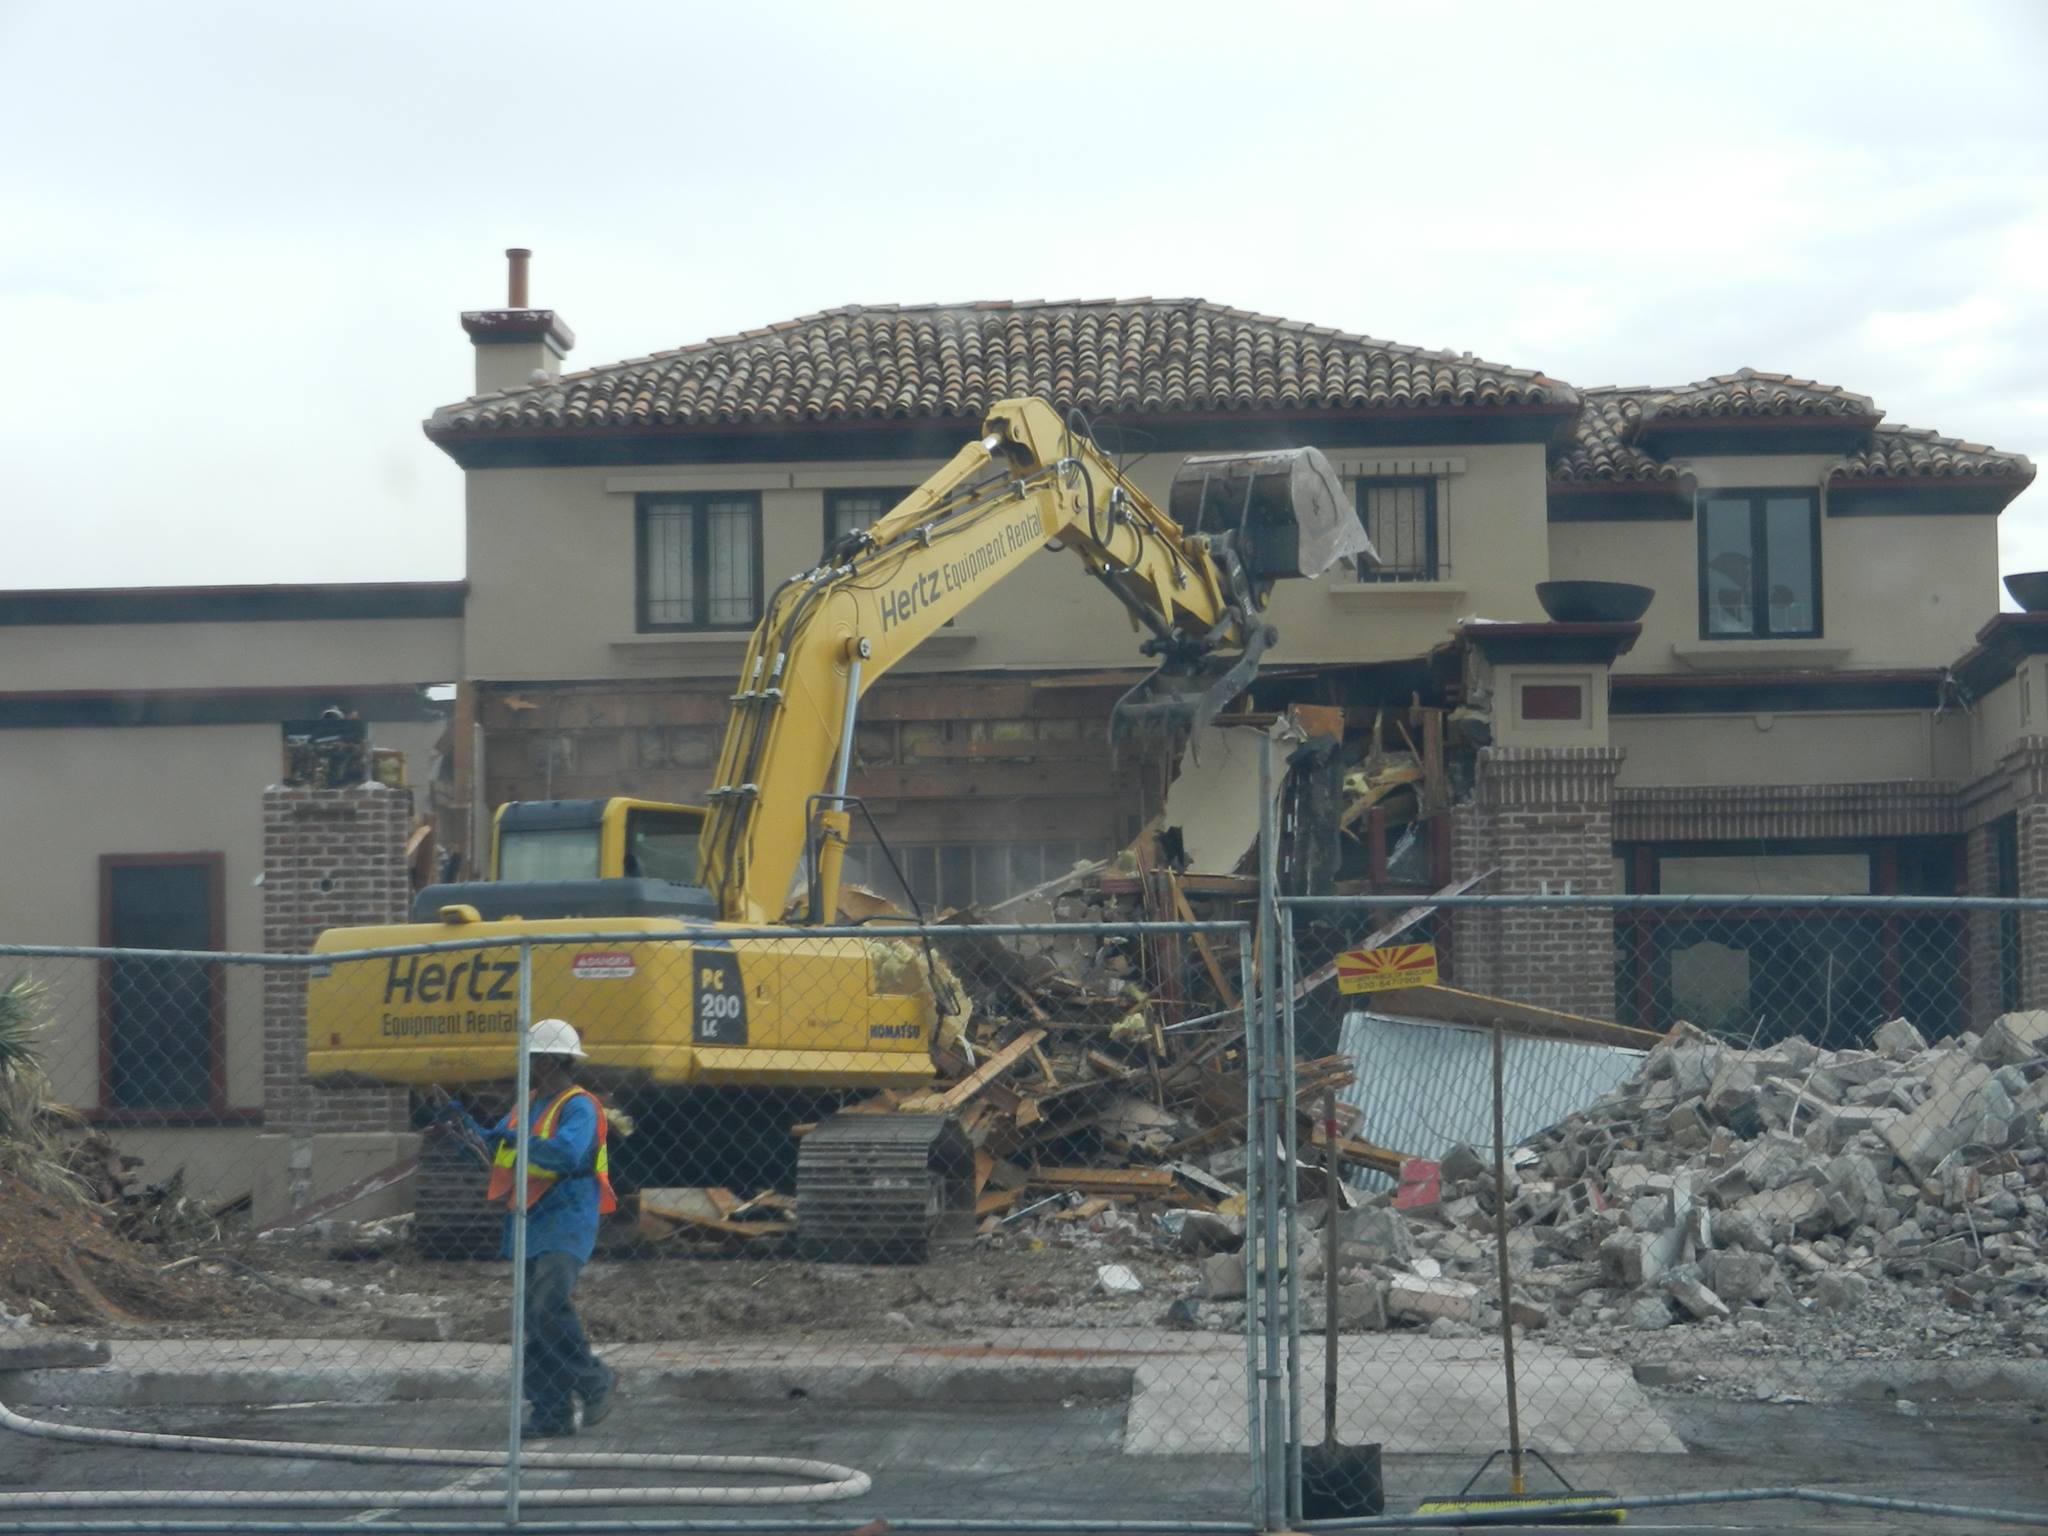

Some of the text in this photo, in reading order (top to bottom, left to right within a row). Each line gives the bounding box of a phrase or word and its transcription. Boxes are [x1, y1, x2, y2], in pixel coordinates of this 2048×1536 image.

[880, 506, 1043, 632] Hertz Equipment Rental
[383, 950, 519, 1004] Hertz
[702, 968, 724, 990] PC
[702, 993, 740, 1018] 200
[383, 1009, 519, 1037] Equipment Rental
[702, 1019, 718, 1037] LC
[870, 1024, 920, 1039] KOMATSU
